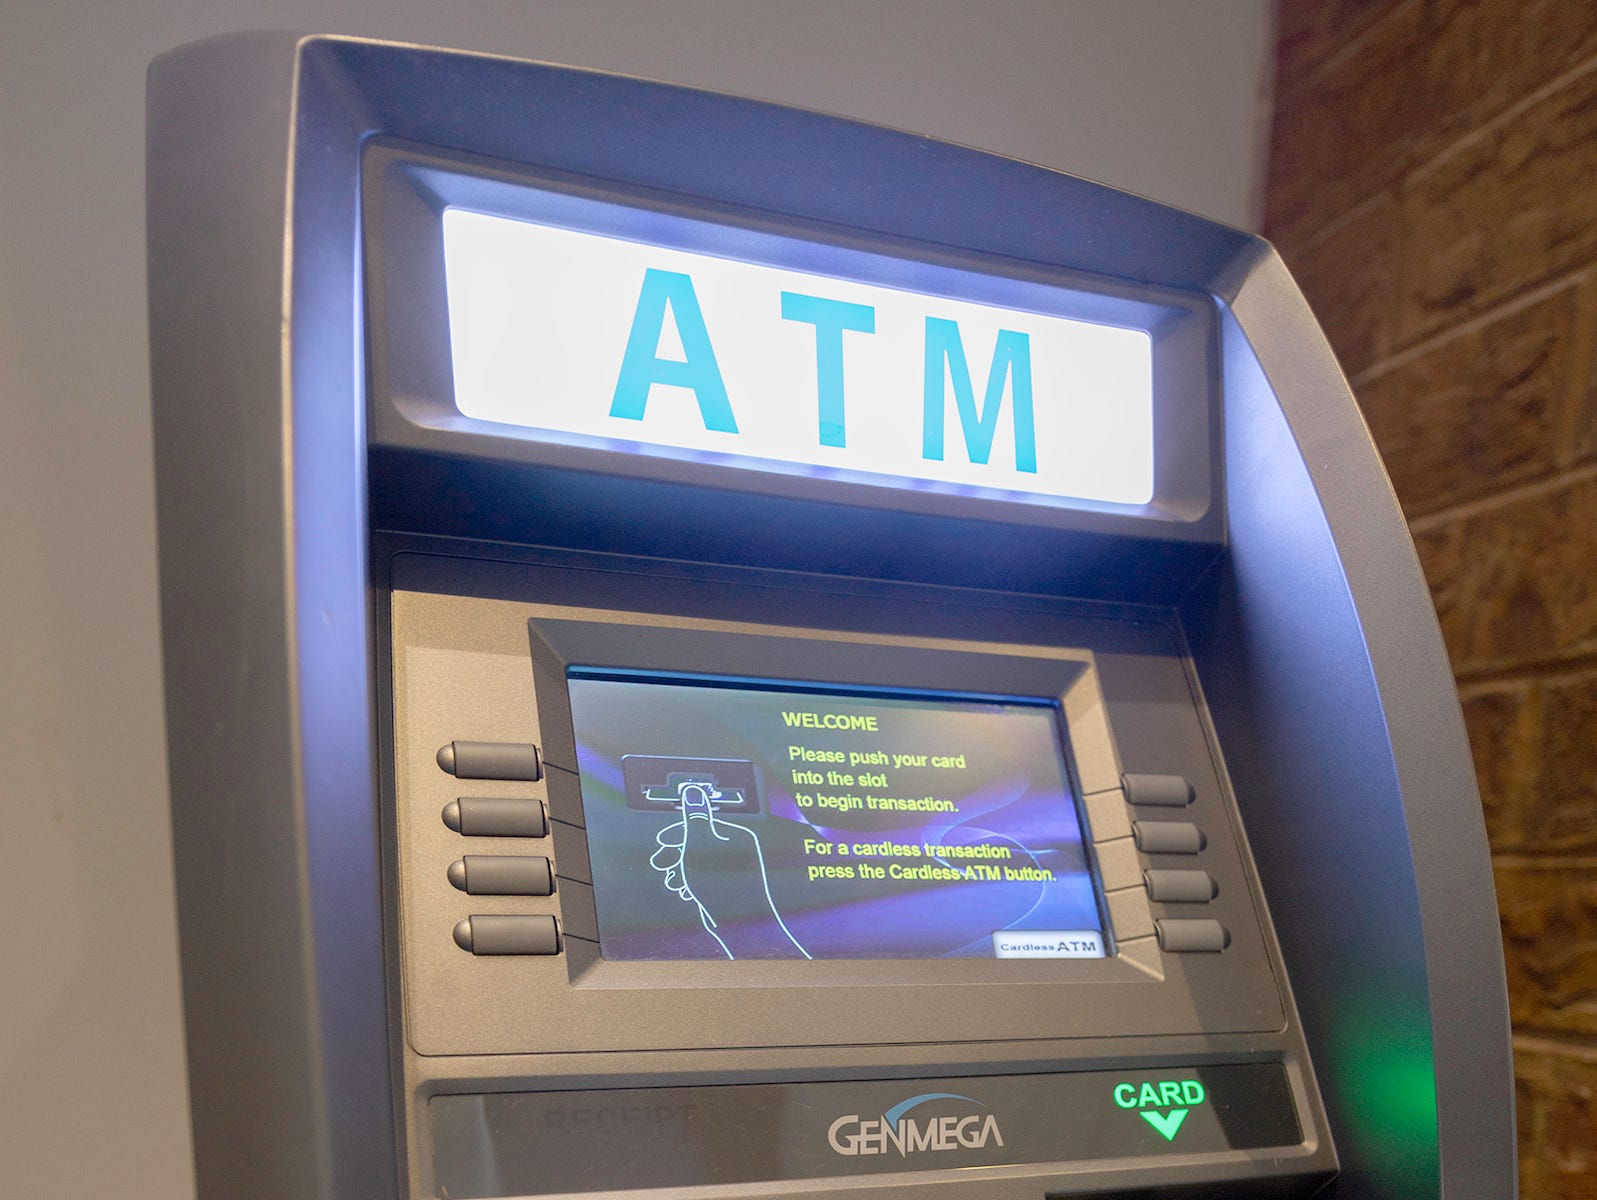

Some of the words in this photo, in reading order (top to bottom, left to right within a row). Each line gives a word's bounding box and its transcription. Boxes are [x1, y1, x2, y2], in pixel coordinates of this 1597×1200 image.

[609, 267, 1038, 474] ATM
[782, 711, 879, 732] WELCOME
[788, 746, 846, 763] Please
[849, 751, 889, 767] push
[892, 754, 928, 768] your
[931, 755, 967, 769] card
[791, 769, 824, 785] into
[827, 771, 854, 786] the
[858, 772, 889, 788] slot
[795, 792, 814, 807] to
[817, 793, 863, 811] begin
[865, 795, 960, 812] transaction.
[803, 839, 833, 855] For
[837, 843, 850, 856] a
[852, 841, 922, 857] cardless
[924, 843, 1011, 859] transaction
[807, 864, 856, 881] press
[858, 864, 885, 878] the
[889, 864, 961, 880] Cardless
[964, 864, 1001, 880] ATM
[1004, 867, 1058, 882] button.
[1113, 1079, 1205, 1109] CARD
